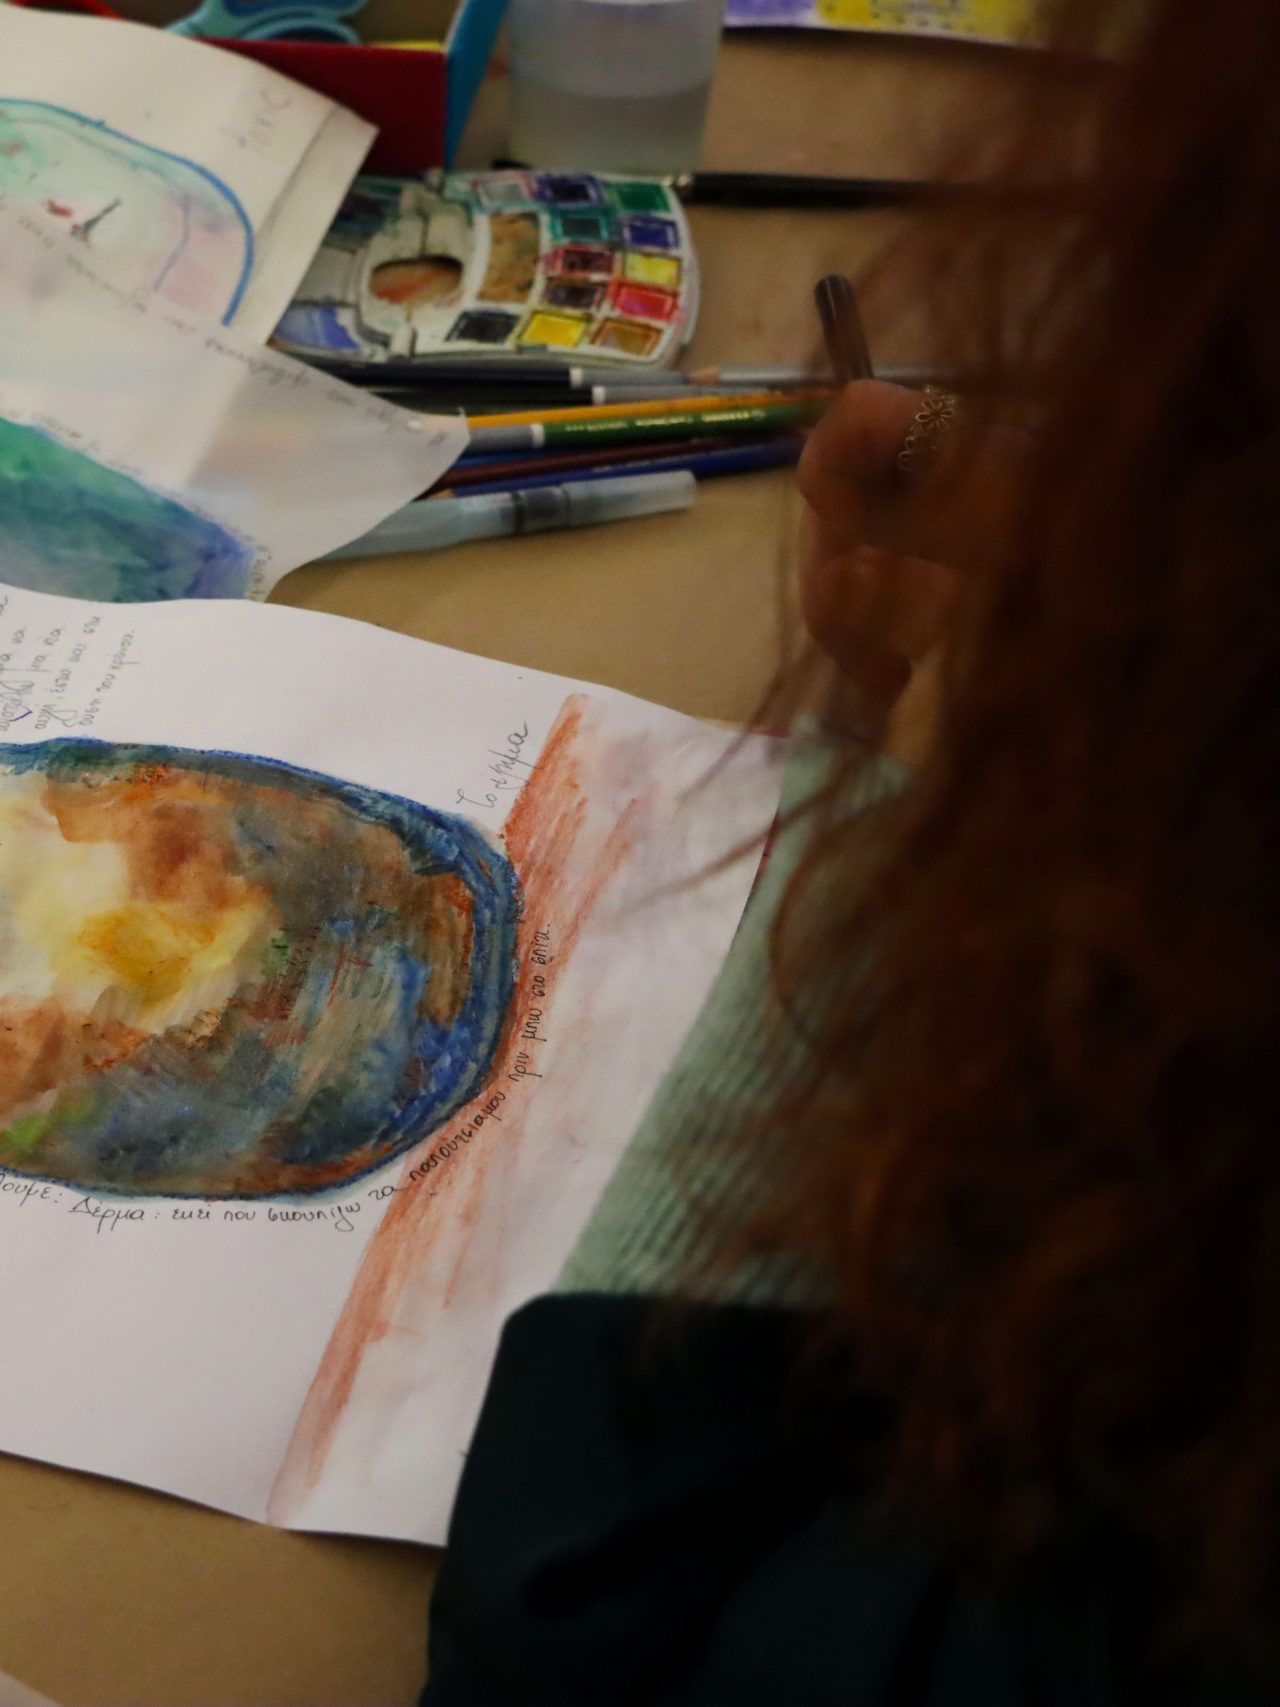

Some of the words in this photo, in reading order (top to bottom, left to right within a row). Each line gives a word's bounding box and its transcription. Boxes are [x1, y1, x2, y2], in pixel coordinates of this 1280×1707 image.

[531, 975, 546, 998] στο
[521, 1007, 548, 1042] μπω
[508, 1051, 543, 1082] πριν
[368, 1185, 405, 1201] τα
[223, 1209, 257, 1222] που
